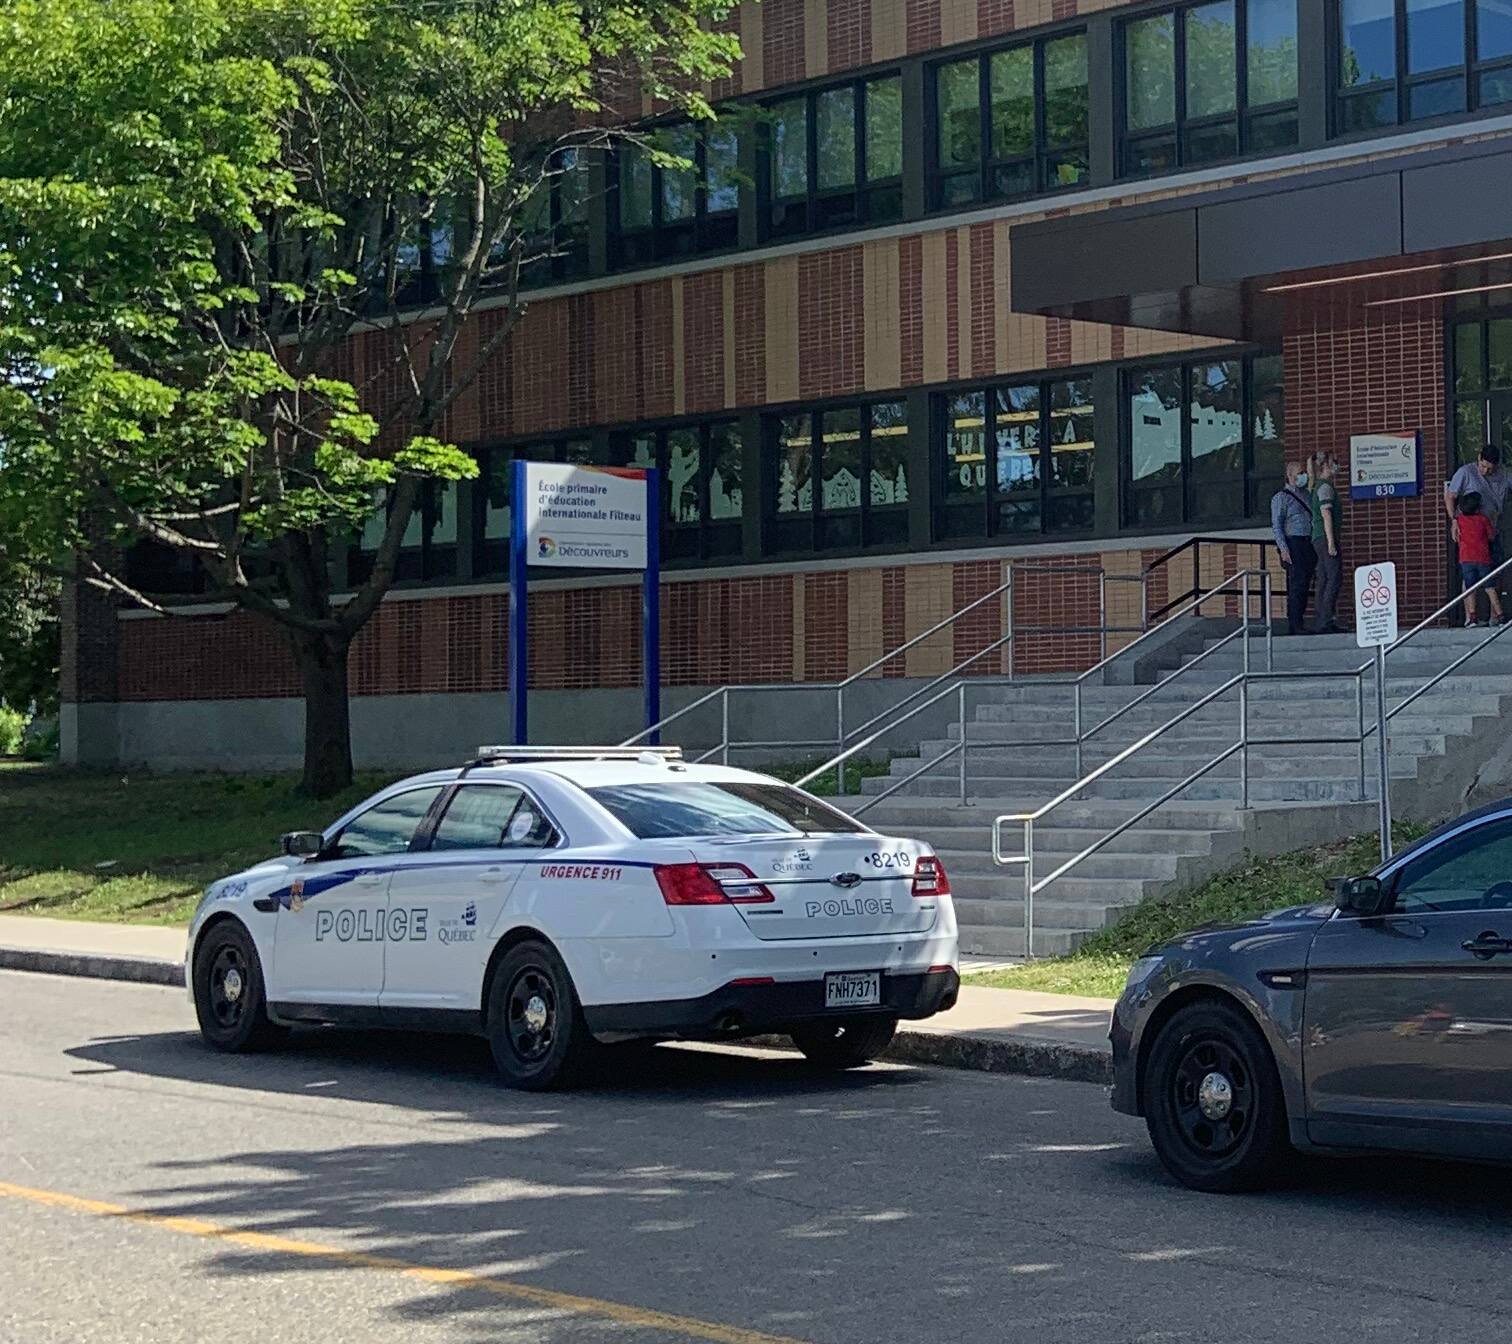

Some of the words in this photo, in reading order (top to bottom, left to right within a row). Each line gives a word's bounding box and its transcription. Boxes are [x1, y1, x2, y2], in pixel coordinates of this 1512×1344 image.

[538, 480, 565, 492] École
[567, 484, 608, 495] primaire
[1375, 484, 1395, 496] 830
[538, 495, 596, 507] d'éducation
[871, 851, 911, 868] 8219
[541, 865, 600, 879] URGENCE
[602, 867, 623, 881] 911
[805, 898, 894, 918] POLICE
[315, 908, 428, 942] POLICE
[828, 979, 878, 999] FNH7371
